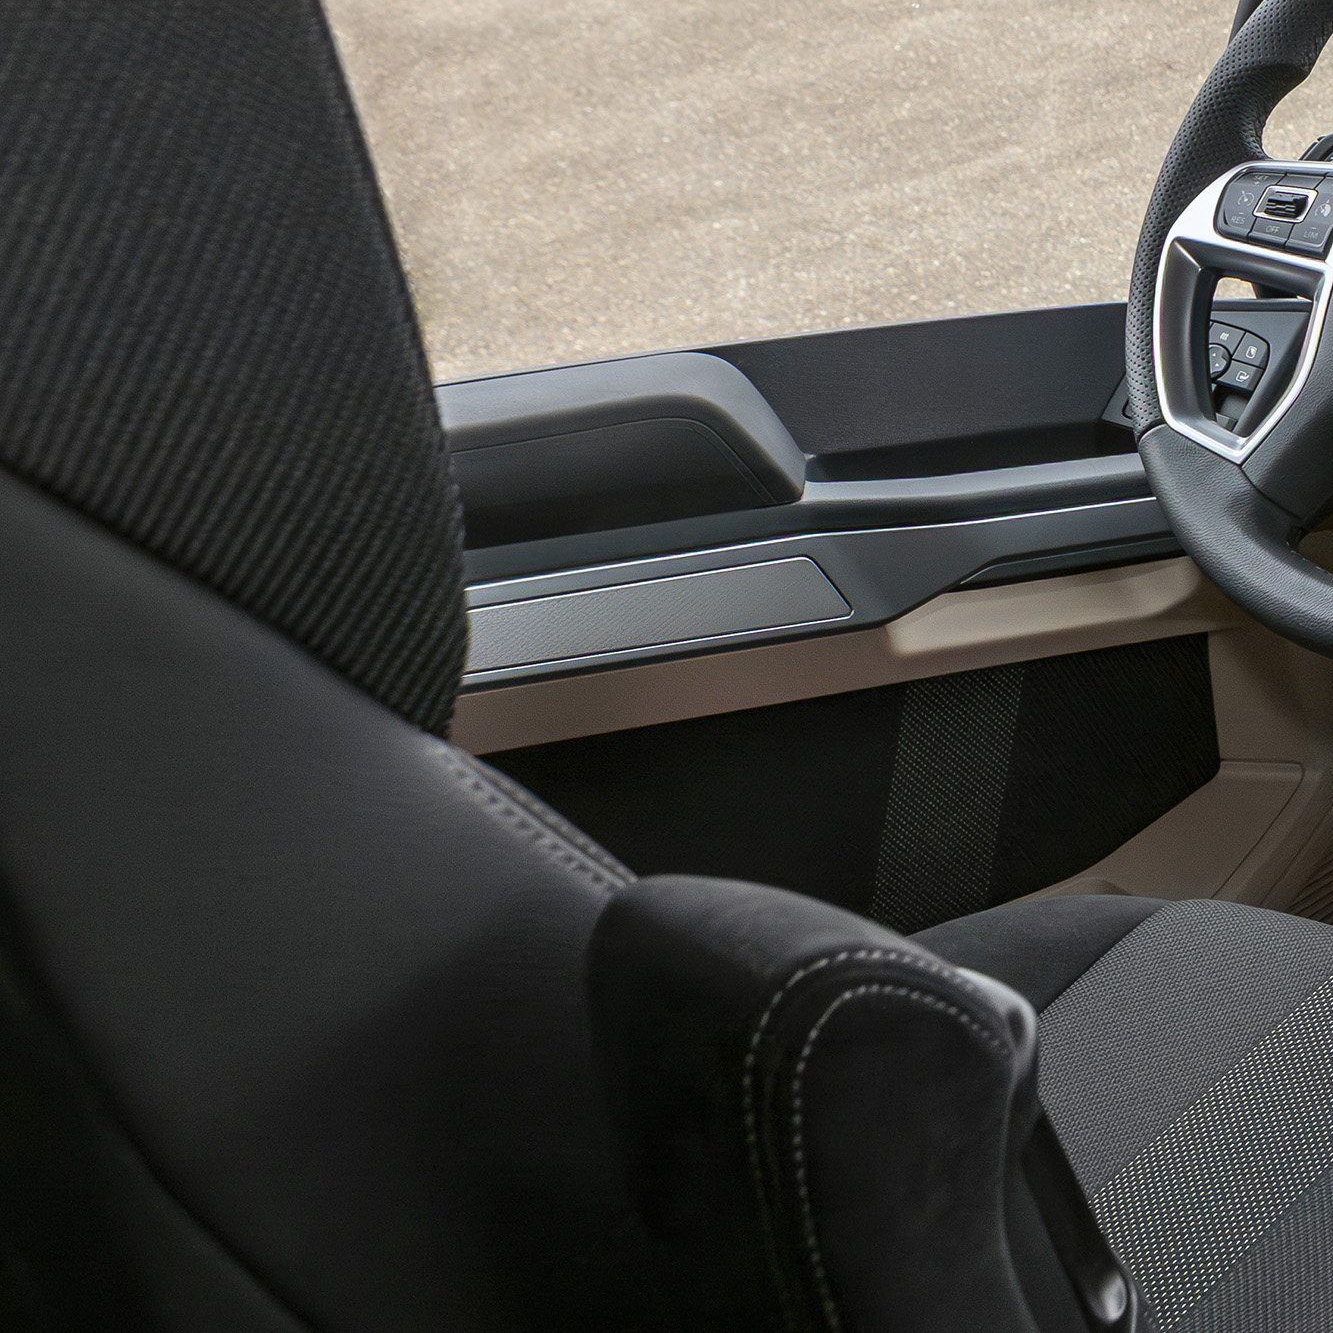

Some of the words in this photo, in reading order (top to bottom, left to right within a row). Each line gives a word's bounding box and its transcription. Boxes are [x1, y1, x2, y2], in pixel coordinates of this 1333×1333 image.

[1230, 216, 1246, 225] RES
[1265, 226, 1280, 234] OFF
[1303, 231, 1319, 239] LIM
